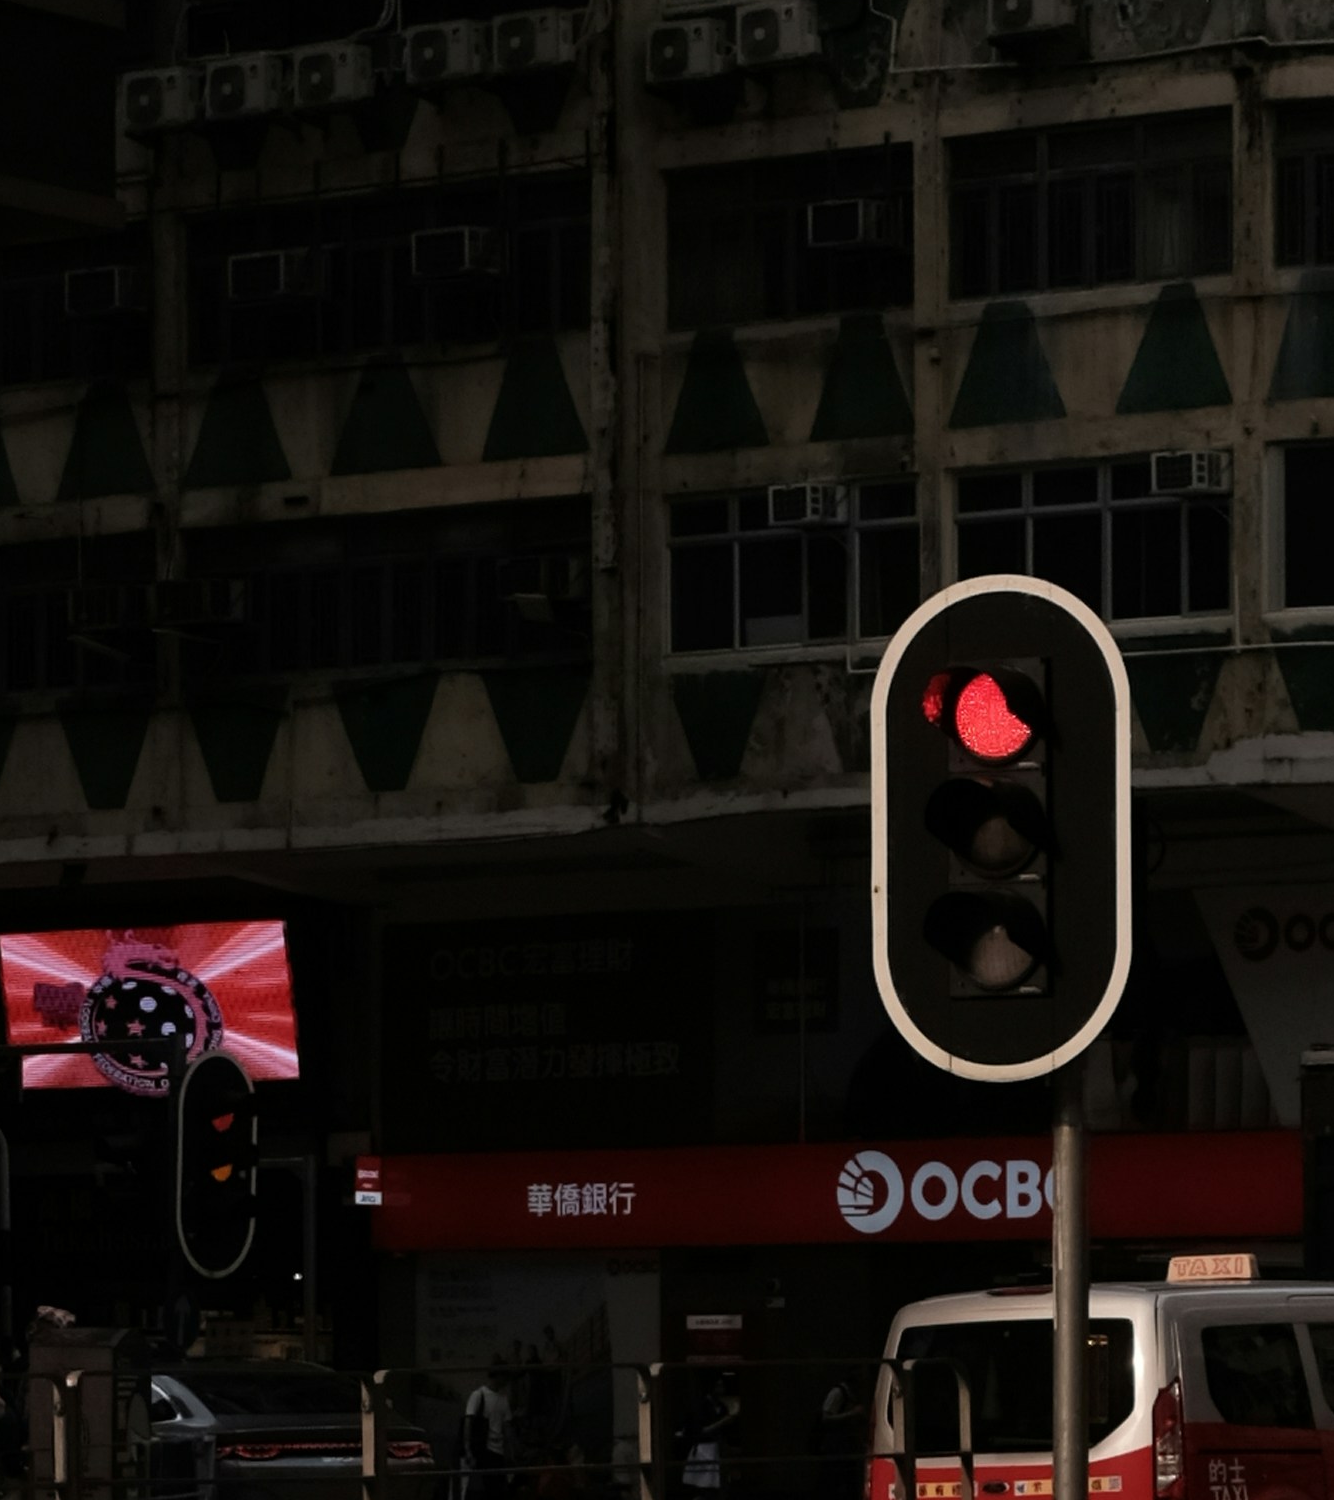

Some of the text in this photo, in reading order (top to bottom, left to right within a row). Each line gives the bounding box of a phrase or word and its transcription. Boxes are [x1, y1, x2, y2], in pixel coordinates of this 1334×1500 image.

[526, 1182, 637, 1217] 華僑銀行
[910, 1159, 1054, 1221] OCB
[1172, 1257, 1245, 1277] TAXI
[1208, 1457, 1246, 1483] 的士
